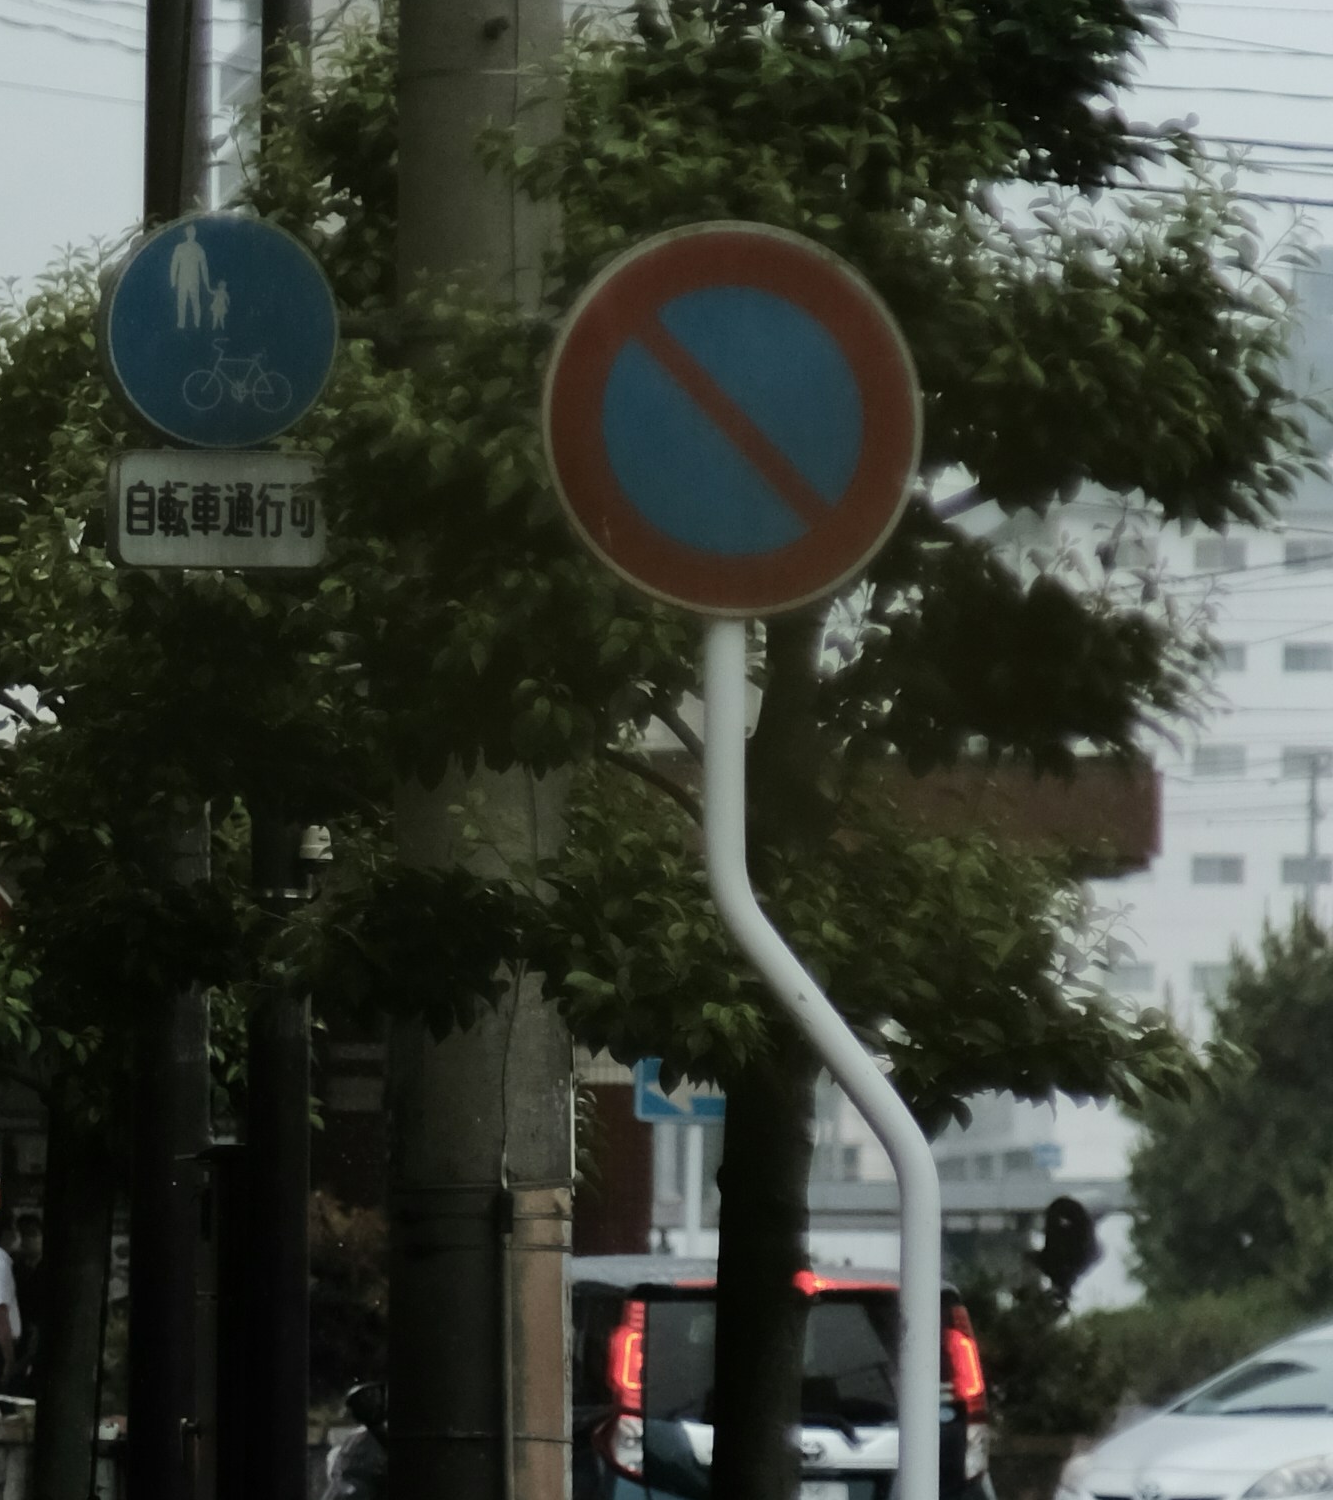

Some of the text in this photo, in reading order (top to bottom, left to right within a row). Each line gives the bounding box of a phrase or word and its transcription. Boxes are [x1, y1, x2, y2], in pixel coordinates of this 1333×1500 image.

[126, 480, 316, 538] 自転車通行可
